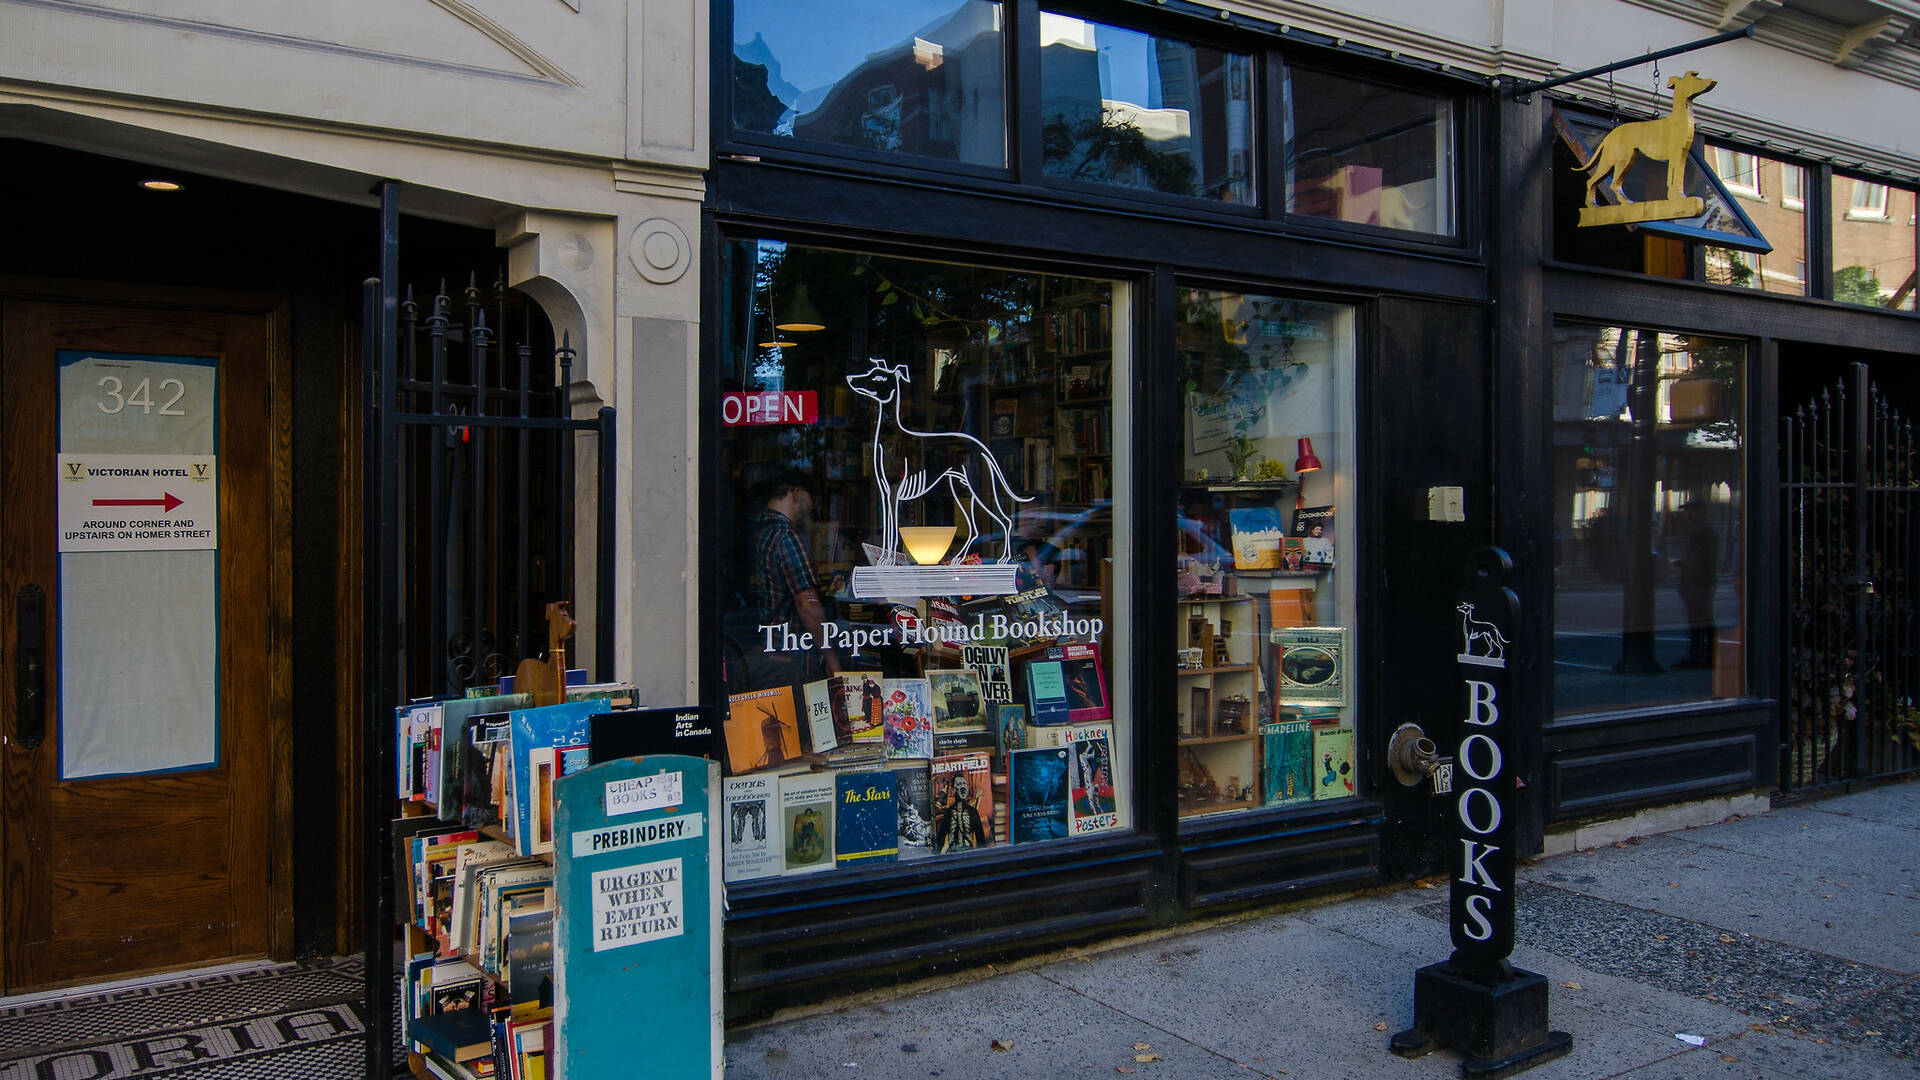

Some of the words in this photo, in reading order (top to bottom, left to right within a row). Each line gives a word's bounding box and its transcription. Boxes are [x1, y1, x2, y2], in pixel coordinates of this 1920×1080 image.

[97, 375, 185, 416] 342
[722, 395, 803, 424] OPEN
[88, 468, 150, 477] VICTORIAN
[153, 468, 188, 477] HOTEL
[83, 520, 126, 529] AROUND
[129, 520, 171, 528] CORNER
[173, 519, 194, 528] AND
[65, 531, 115, 540] UPSTAIRS
[117, 531, 132, 539] ON
[135, 530, 171, 539] HOMER
[173, 530, 211, 538] STREET
[758, 622, 813, 652] The
[820, 622, 894, 657] Paper
[899, 613, 986, 645] Hound
[991, 610, 1104, 643] Bookshop
[964, 646, 1006, 665] OGILVY
[970, 664, 989, 682] N
[980, 682, 1011, 700] VER-
[675, 713, 699, 722] Indian
[675, 721, 693, 729] Arts
[675, 729, 683, 737] in
[683, 727, 712, 737] Canada
[1065, 728, 1107, 743] Hockney
[1266, 722, 1311, 736] MADELINE
[932, 759, 988, 774] HEARTFIELD
[609, 777, 653, 793] CHEAP
[612, 788, 657, 805] BOOKS
[845, 789, 862, 804] The
[862, 786, 891, 802] Stars
[1459, 679, 1502, 941] BOOKS
[1075, 814, 1118, 832] Posters
[592, 820, 686, 850] PREBINDERY
[599, 867, 678, 892] URGENT
[608, 885, 665, 907] WHEN
[605, 900, 673, 925] EMPTY
[600, 916, 679, 942] RETURN
[0, 1009, 360, 1080] ORIA
